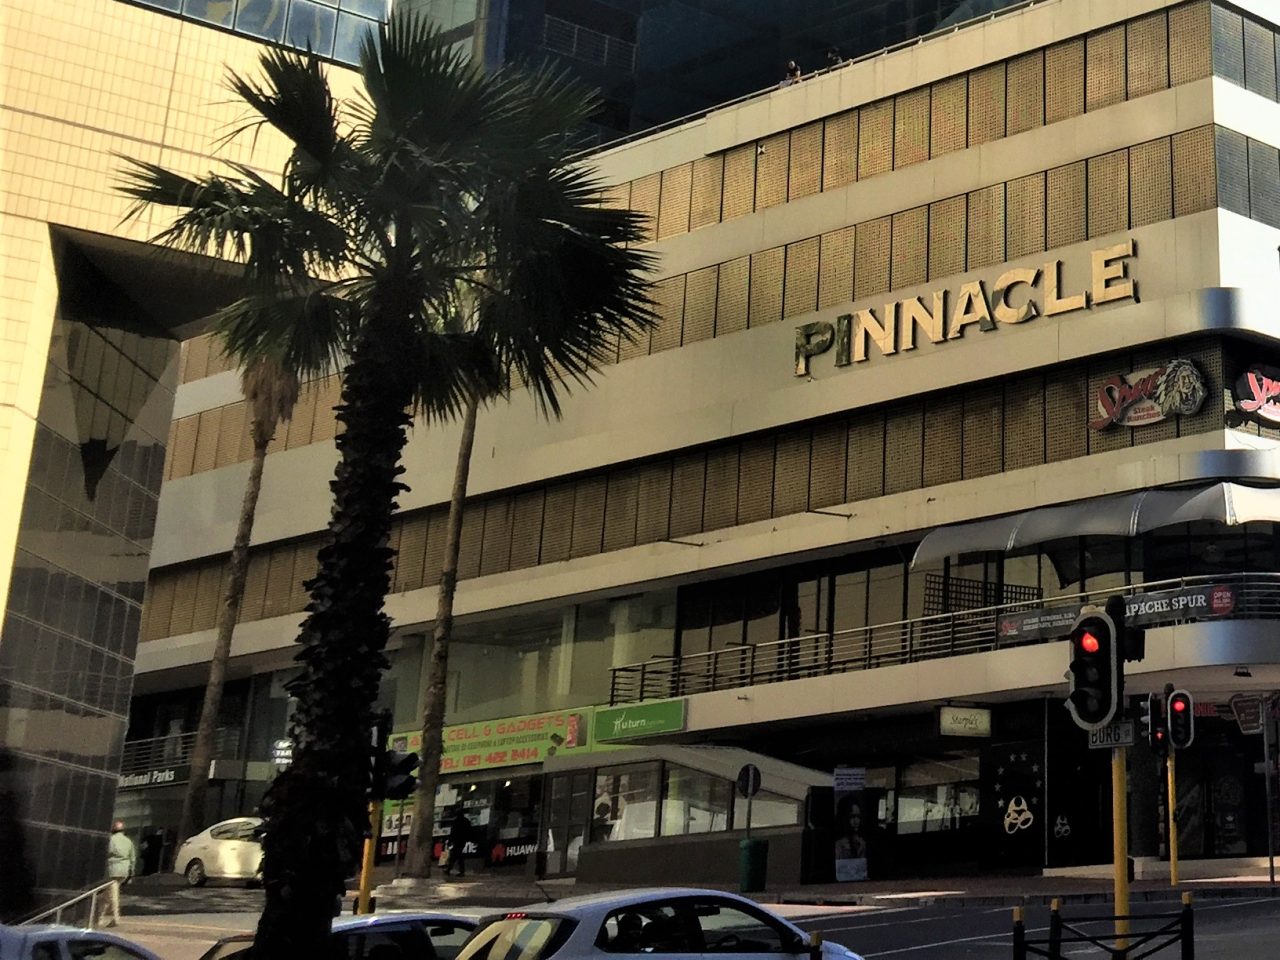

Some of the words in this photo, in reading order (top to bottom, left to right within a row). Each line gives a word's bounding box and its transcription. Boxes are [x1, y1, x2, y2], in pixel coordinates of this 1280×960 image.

[794, 238, 1140, 377] PINNACLE
[1171, 594, 1207, 610] SPUR
[1213, 591, 1232, 599] OPEN
[447, 727, 480, 742] CELL
[496, 715, 565, 735] GADGETS
[1092, 726, 1121, 744] BURG
[151, 769, 175, 783] Parks
